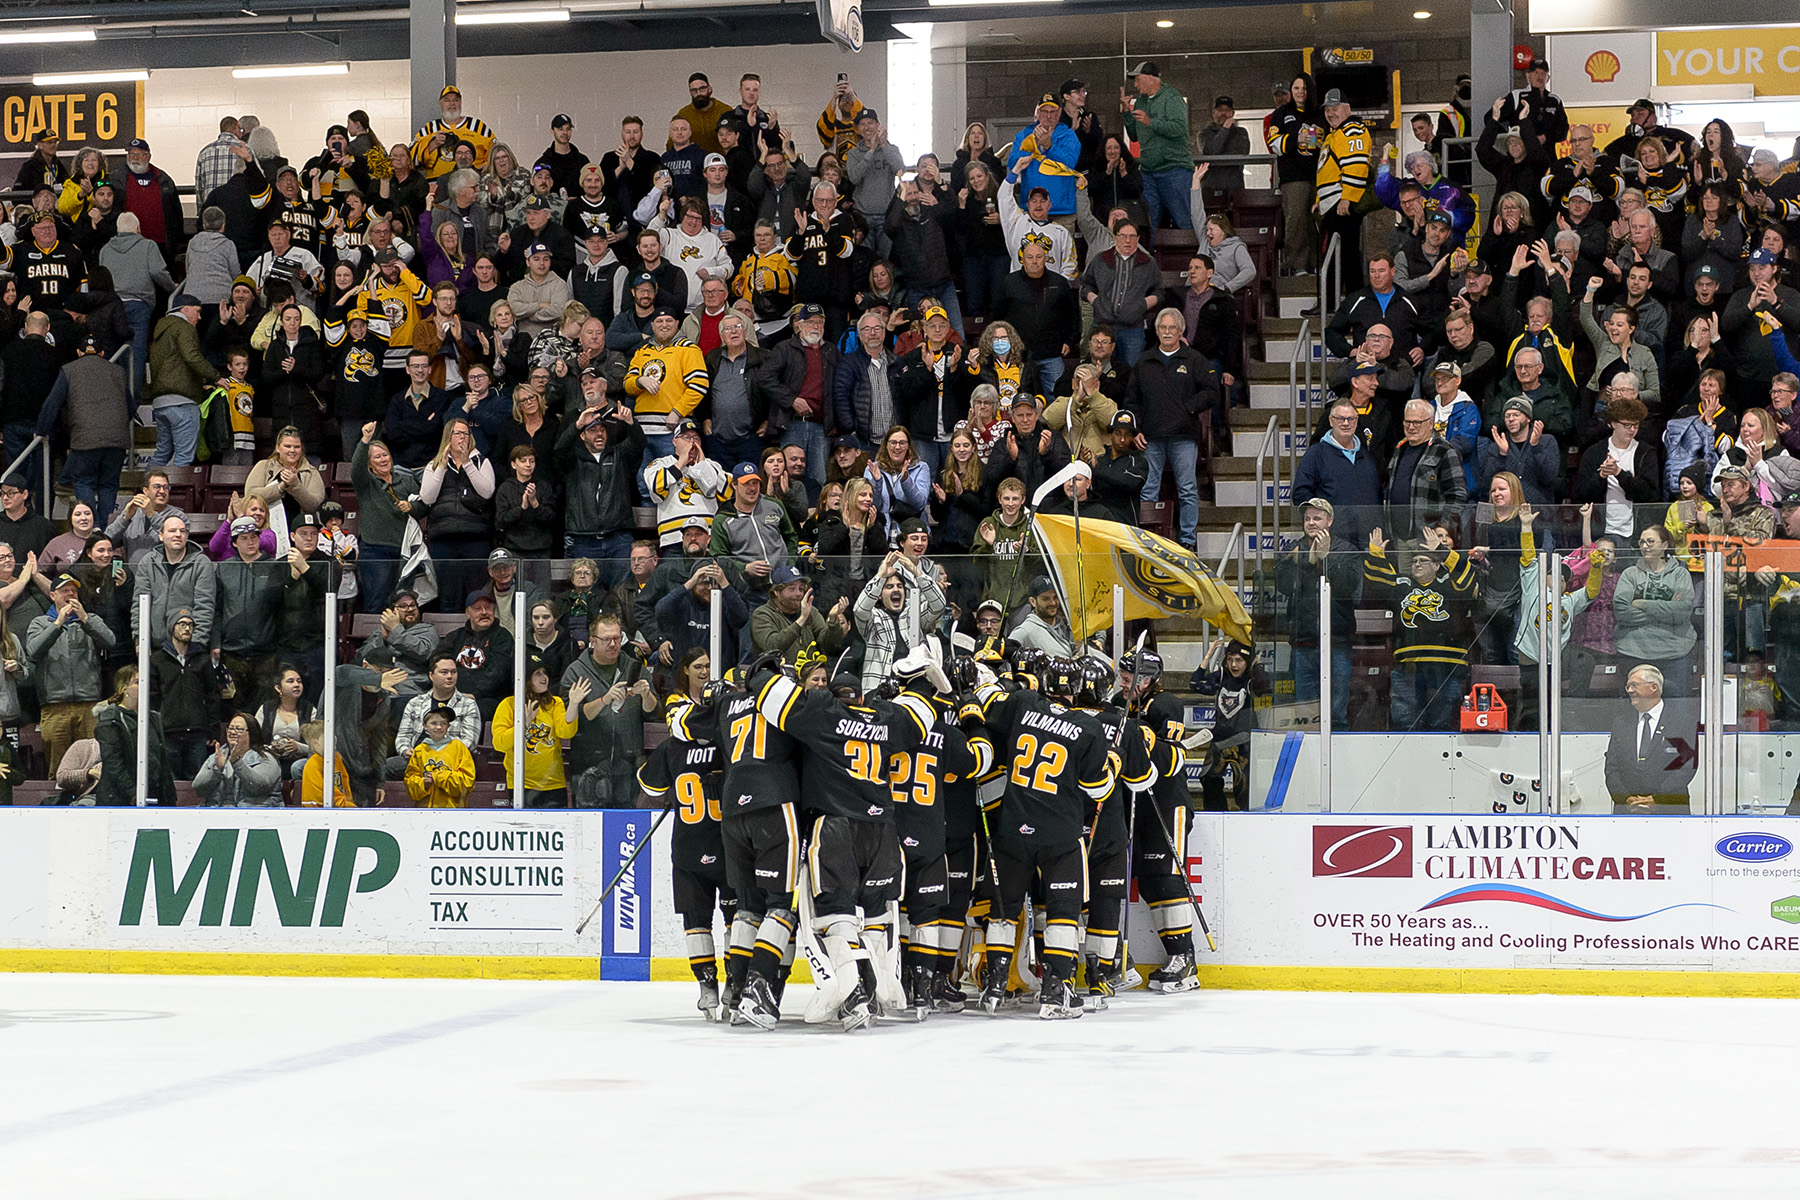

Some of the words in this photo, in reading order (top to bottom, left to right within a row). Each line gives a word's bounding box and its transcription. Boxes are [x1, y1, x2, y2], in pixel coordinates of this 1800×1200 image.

[1345, 50, 1372, 60] 50/50
[1662, 46, 1764, 76] YOUR
[3, 93, 87, 143] GATE
[96, 92, 118, 141] 6
[1348, 138, 1364, 153] 70
[292, 226, 310, 242] 25
[817, 250, 827, 266] 3
[27, 263, 70, 279] SARNIA
[41, 280, 58, 294] 18
[835, 718, 889, 742] SURZYCIA
[1020, 710, 1083, 741] VILMANIS
[1167, 720, 1185, 741] 77
[1476, 714, 1488, 727] G
[730, 712, 768, 764] 71
[686, 747, 716, 765] VOIT
[844, 740, 887, 785] 31
[1010, 732, 1068, 795] 22
[889, 751, 938, 806] 25
[430, 831, 564, 851] ACCOUNTING
[1424, 825, 1581, 850] LAMBTON
[1726, 840, 1784, 854] Carrier
[118, 828, 402, 927] MNP
[431, 865, 564, 887] CONSULTING
[619, 822, 636, 931] WINMAR.ca
[755, 869, 779, 878] CCM
[1425, 855, 1666, 881] CLIMATECARE
[1706, 868, 1727, 877] turn
[1730, 868, 1740, 877] to
[1743, 867, 1760, 877] the
[865, 877, 894, 886] CCM
[918, 884, 944, 893] CCM
[1050, 881, 1078, 890] CCM
[1100, 878, 1125, 886] CCM
[430, 902, 469, 922] TAX
[1313, 913, 1364, 928] OVER
[1370, 914, 1391, 928] 50
[1396, 914, 1446, 929] Years
[1452, 918, 1488, 929] as...
[1351, 932, 1384, 947] The
[1389, 933, 1456, 951] Heating
[1461, 933, 1493, 948] and
[1499, 933, 1567, 952] Cooling
[1573, 934, 1695, 950] Professionals
[1700, 936, 1741, 951] Who
[1746, 936, 1799, 951] CARE
[804, 945, 831, 981] CCM
